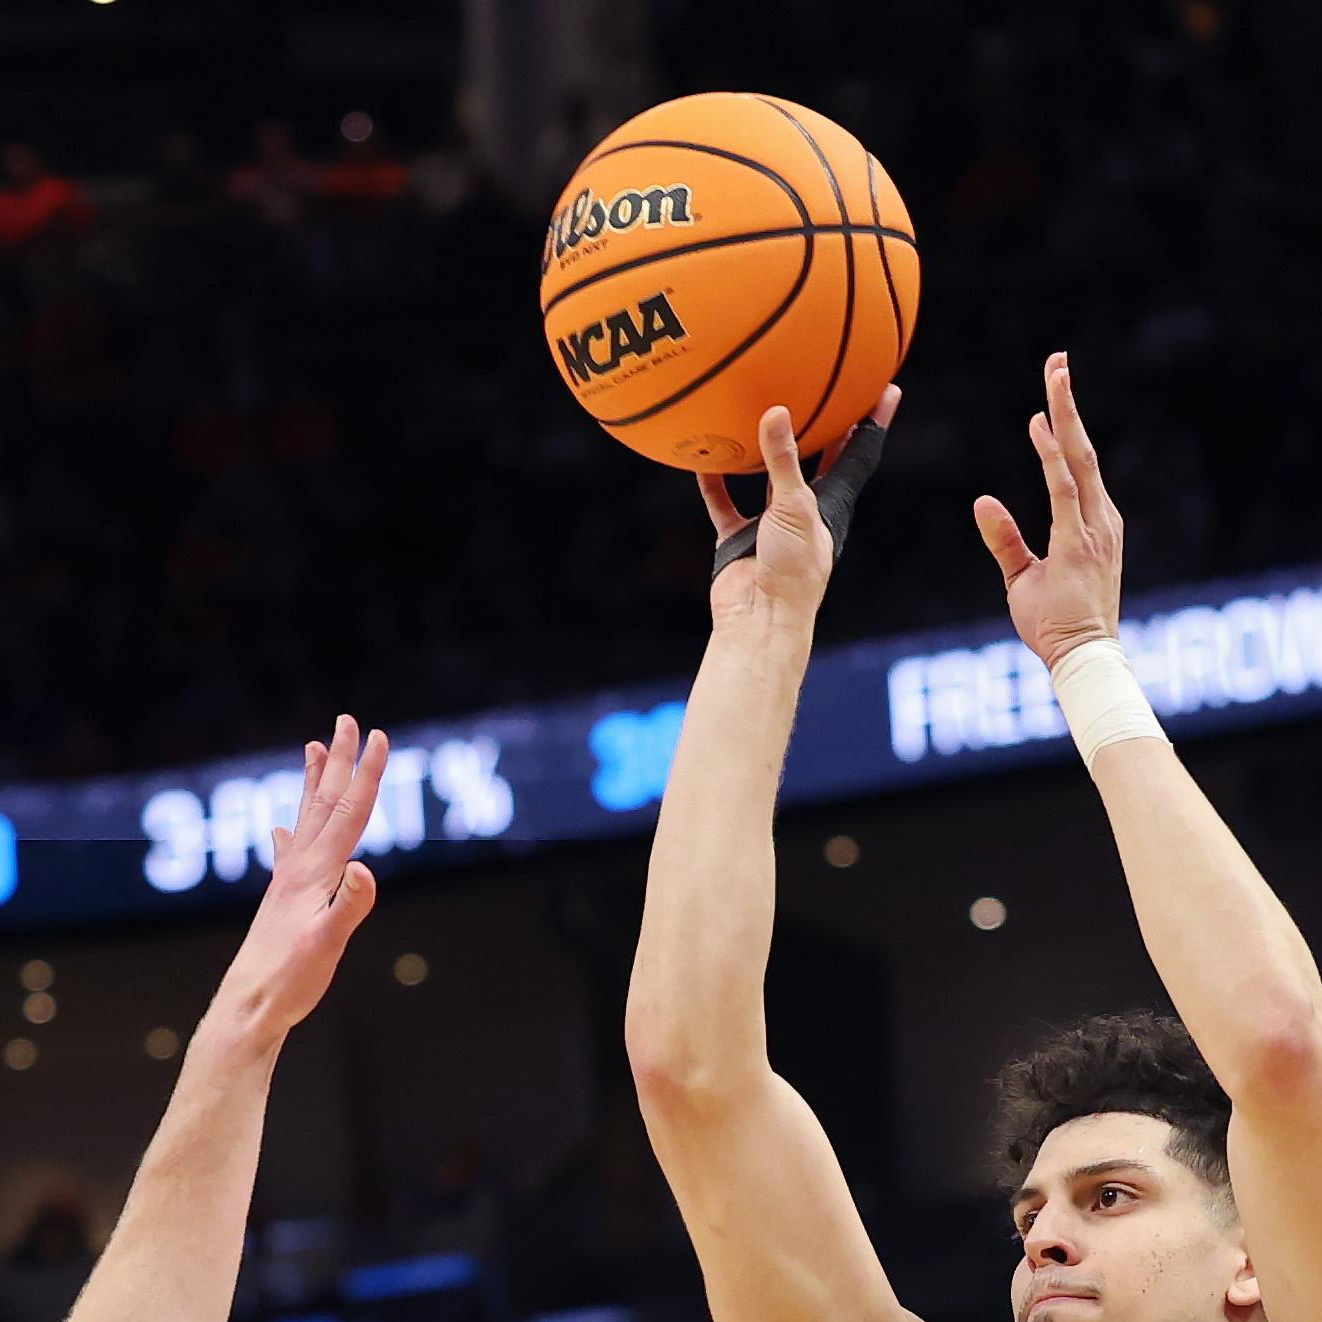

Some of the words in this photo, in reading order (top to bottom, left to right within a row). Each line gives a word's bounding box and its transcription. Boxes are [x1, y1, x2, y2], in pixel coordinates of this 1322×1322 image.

[542, 184, 694, 274] ilson
[557, 291, 690, 387] NCAA
[430, 735, 514, 839] %
